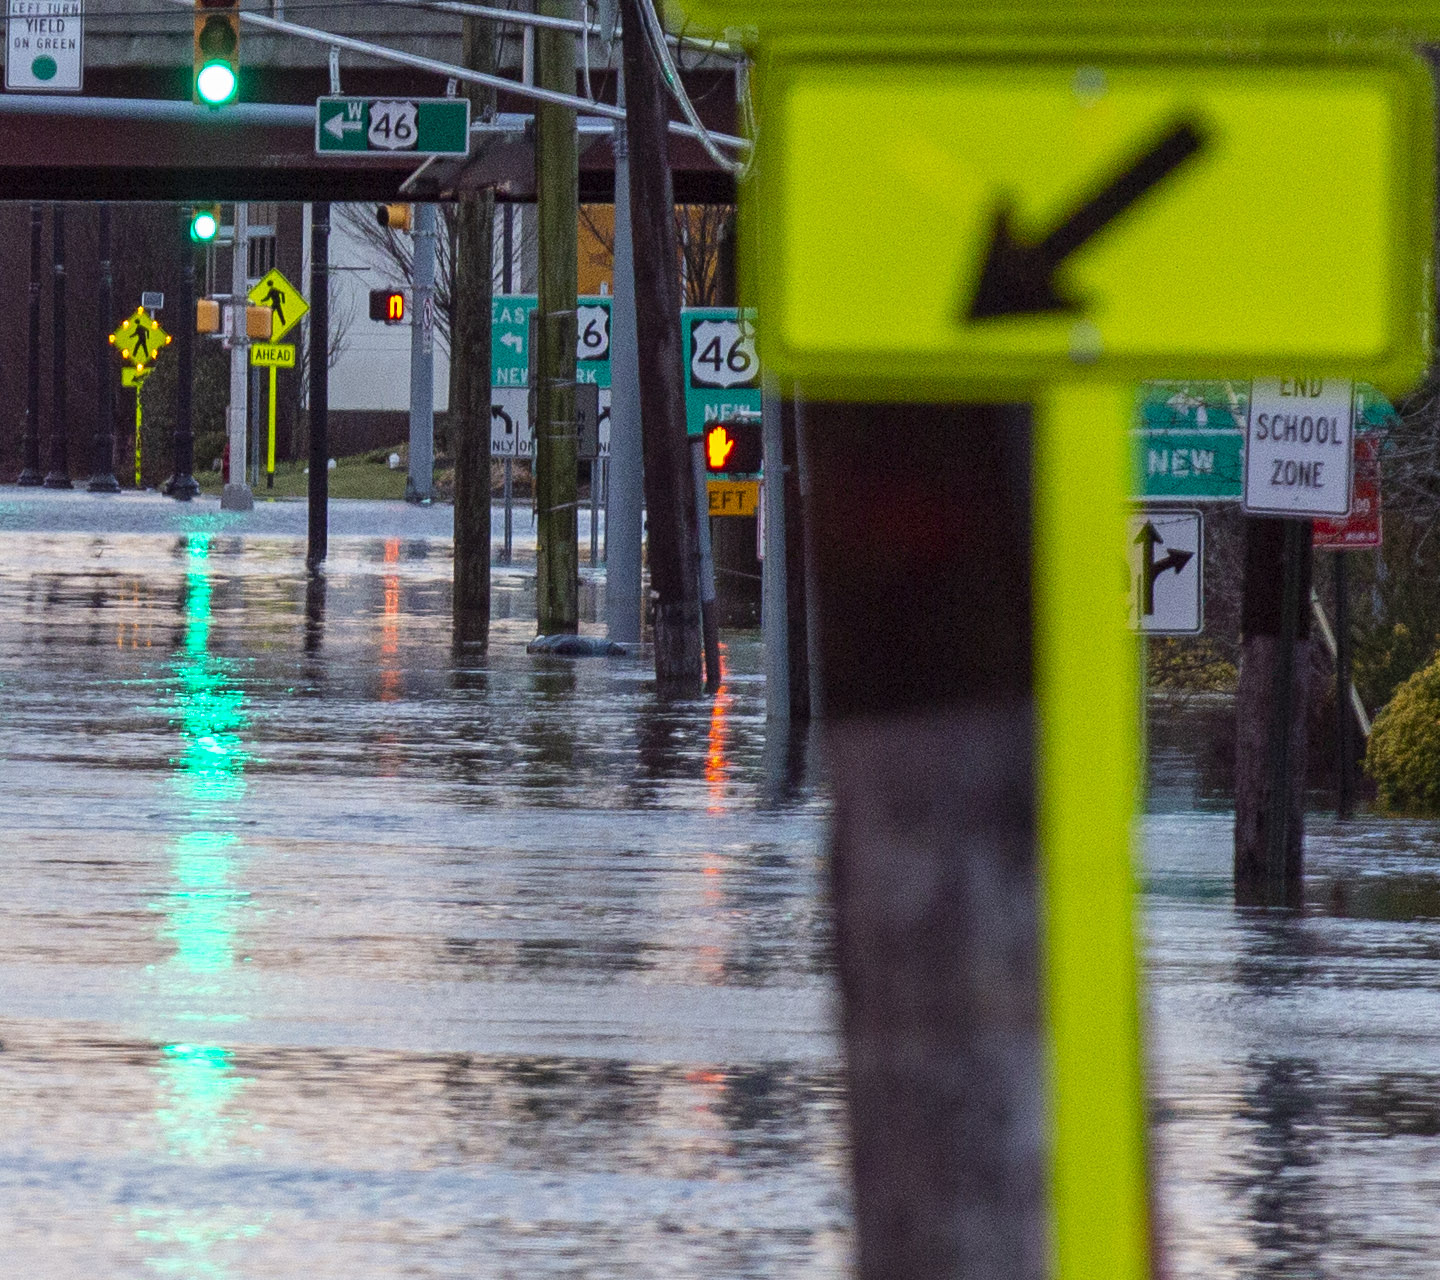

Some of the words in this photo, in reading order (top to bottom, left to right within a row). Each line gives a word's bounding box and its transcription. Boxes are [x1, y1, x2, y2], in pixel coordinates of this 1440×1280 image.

[12, 2, 40, 14] LEFT
[48, 3, 79, 16] TURN
[26, 18, 65, 33] YIELD
[14, 38, 29, 50] ON
[36, 38, 76, 50] GREEN
[347, 102, 363, 120] W
[373, 113, 412, 140] 46
[491, 302, 530, 325] EAS
[576, 318, 603, 348] 6
[255, 349, 291, 361] AHEAD
[697, 334, 752, 373] 46
[576, 368, 597, 384] RK
[1279, 375, 1321, 399] END
[1256, 413, 1343, 446] SCHOOL
[492, 440, 514, 452] NLY
[1147, 448, 1215, 476] NEW
[1270, 459, 1326, 489] ZONE
[708, 490, 747, 509] EFT
